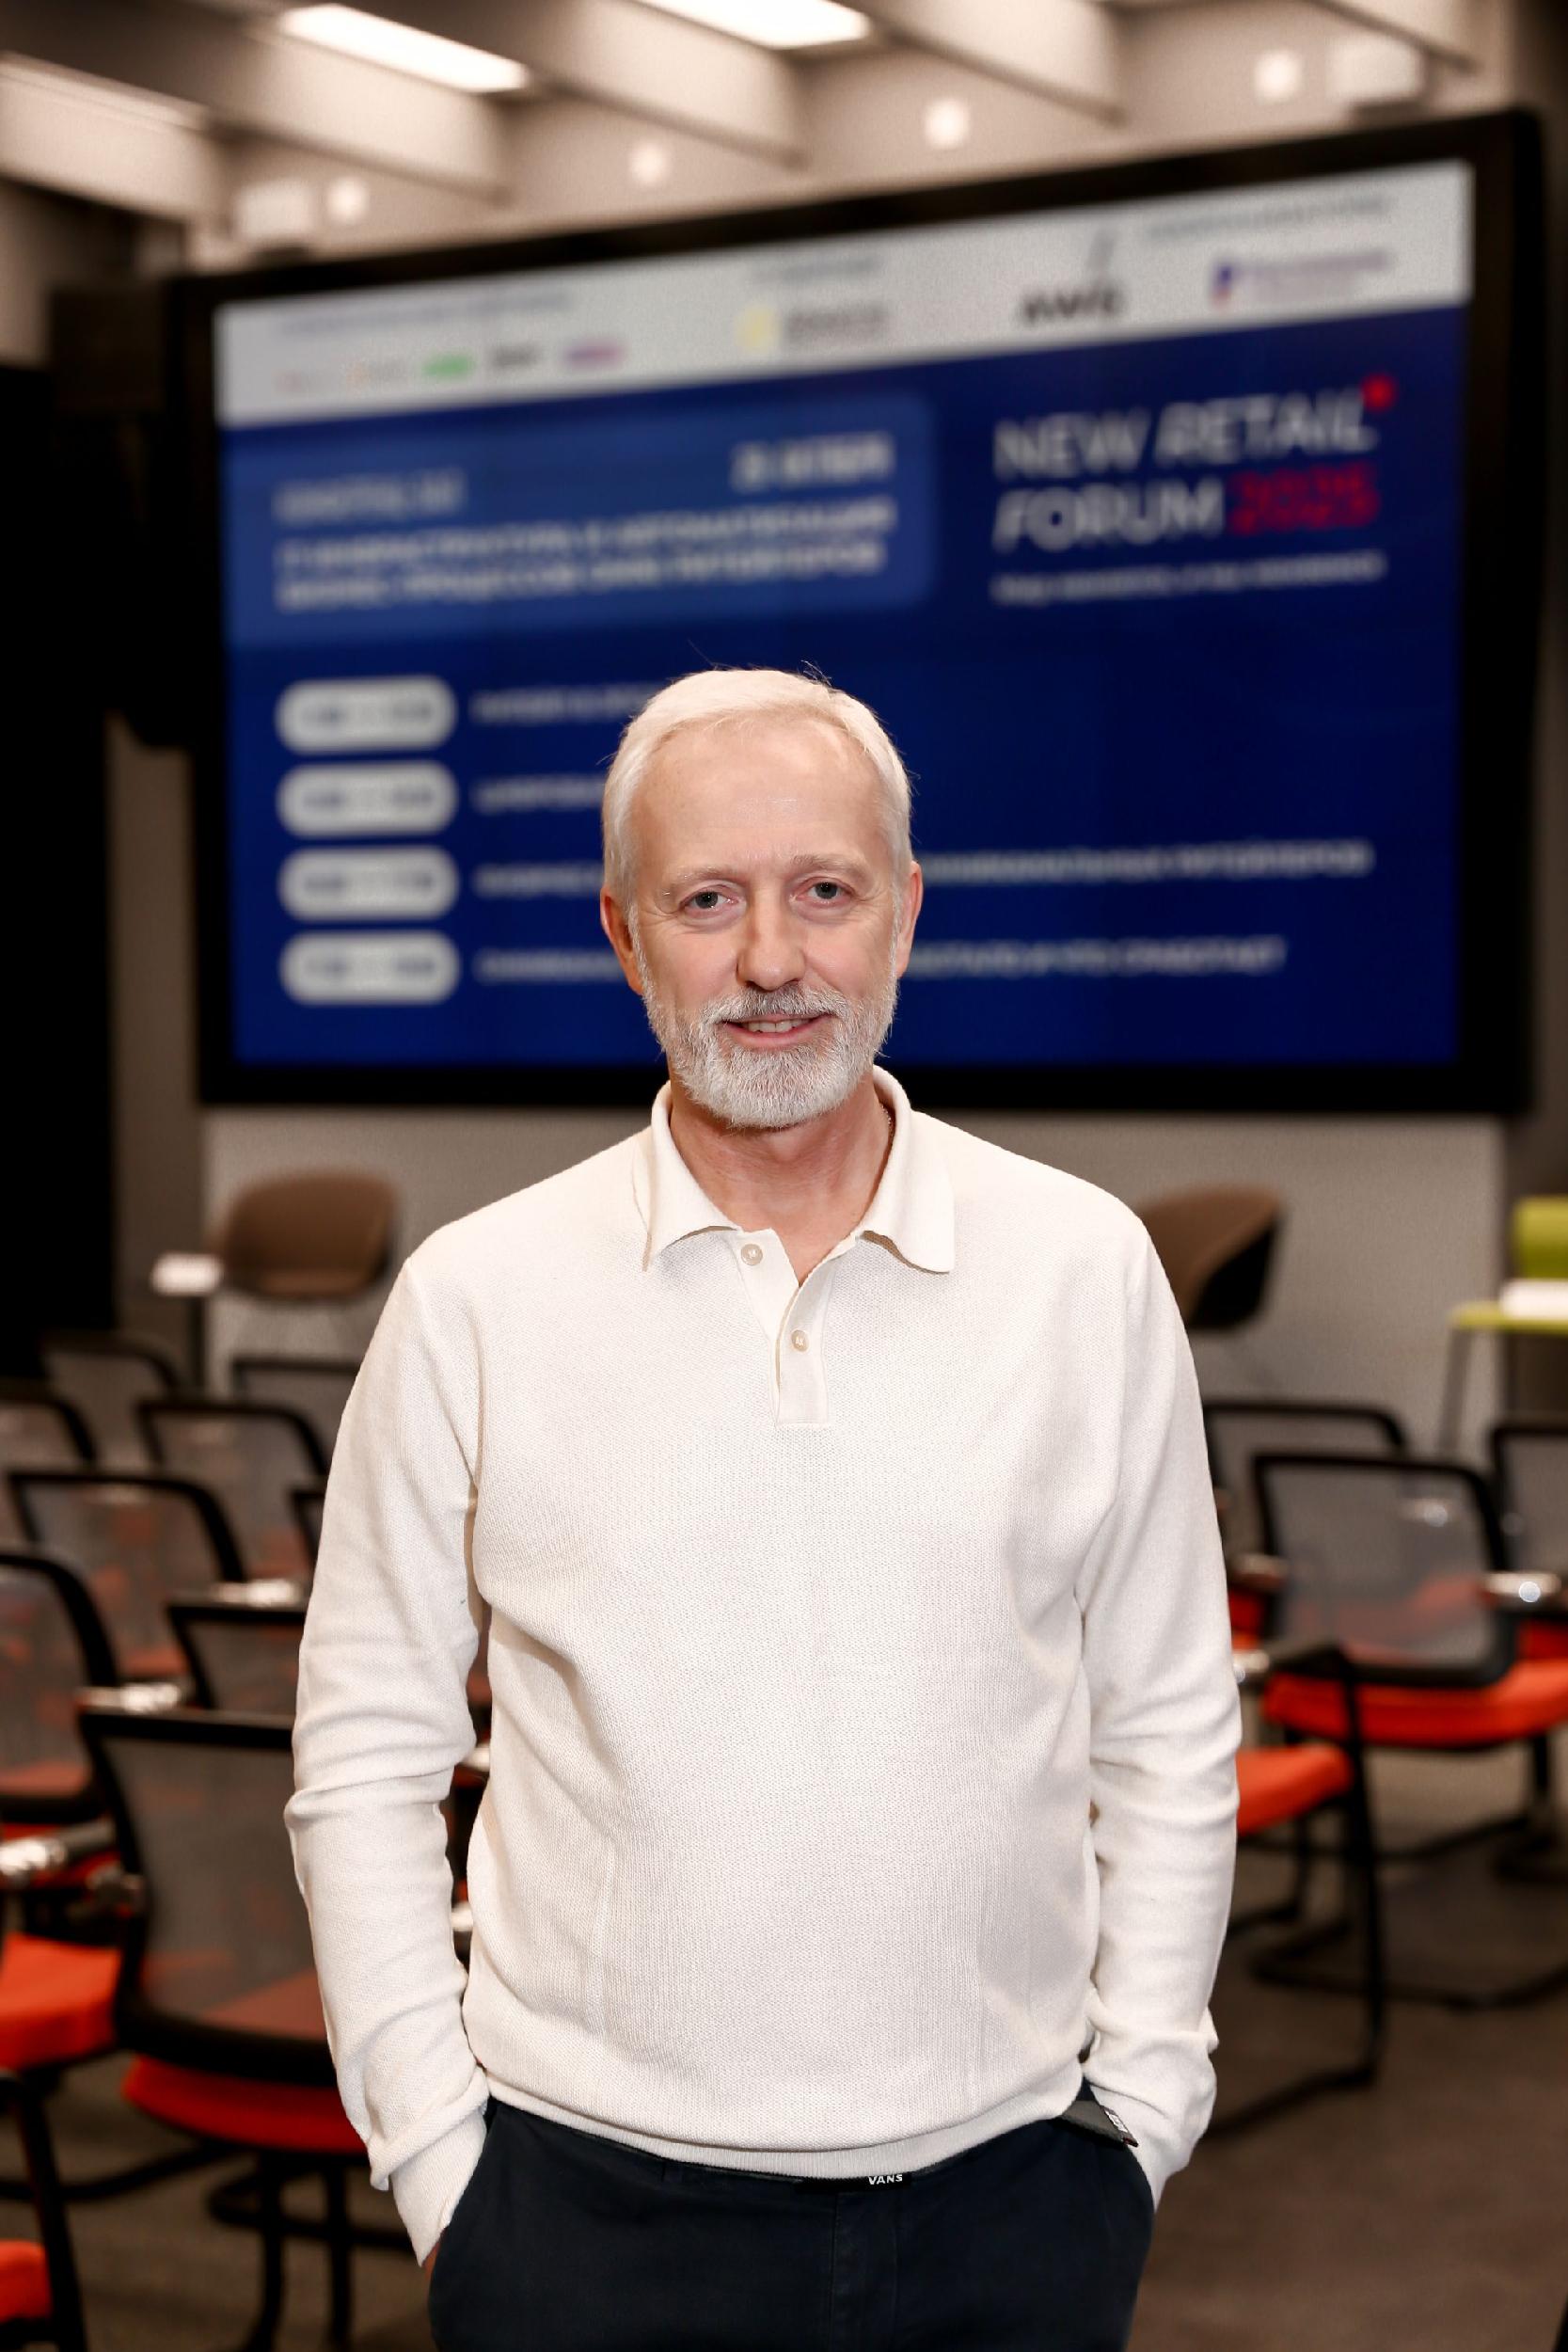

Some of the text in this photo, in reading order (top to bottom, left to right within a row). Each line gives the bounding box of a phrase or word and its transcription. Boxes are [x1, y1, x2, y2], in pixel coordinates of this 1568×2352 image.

[995, 388, 1377, 478] NEW RETAIL
[994, 478, 1224, 549] FORUM
[868, 2174, 903, 2185] VANS
